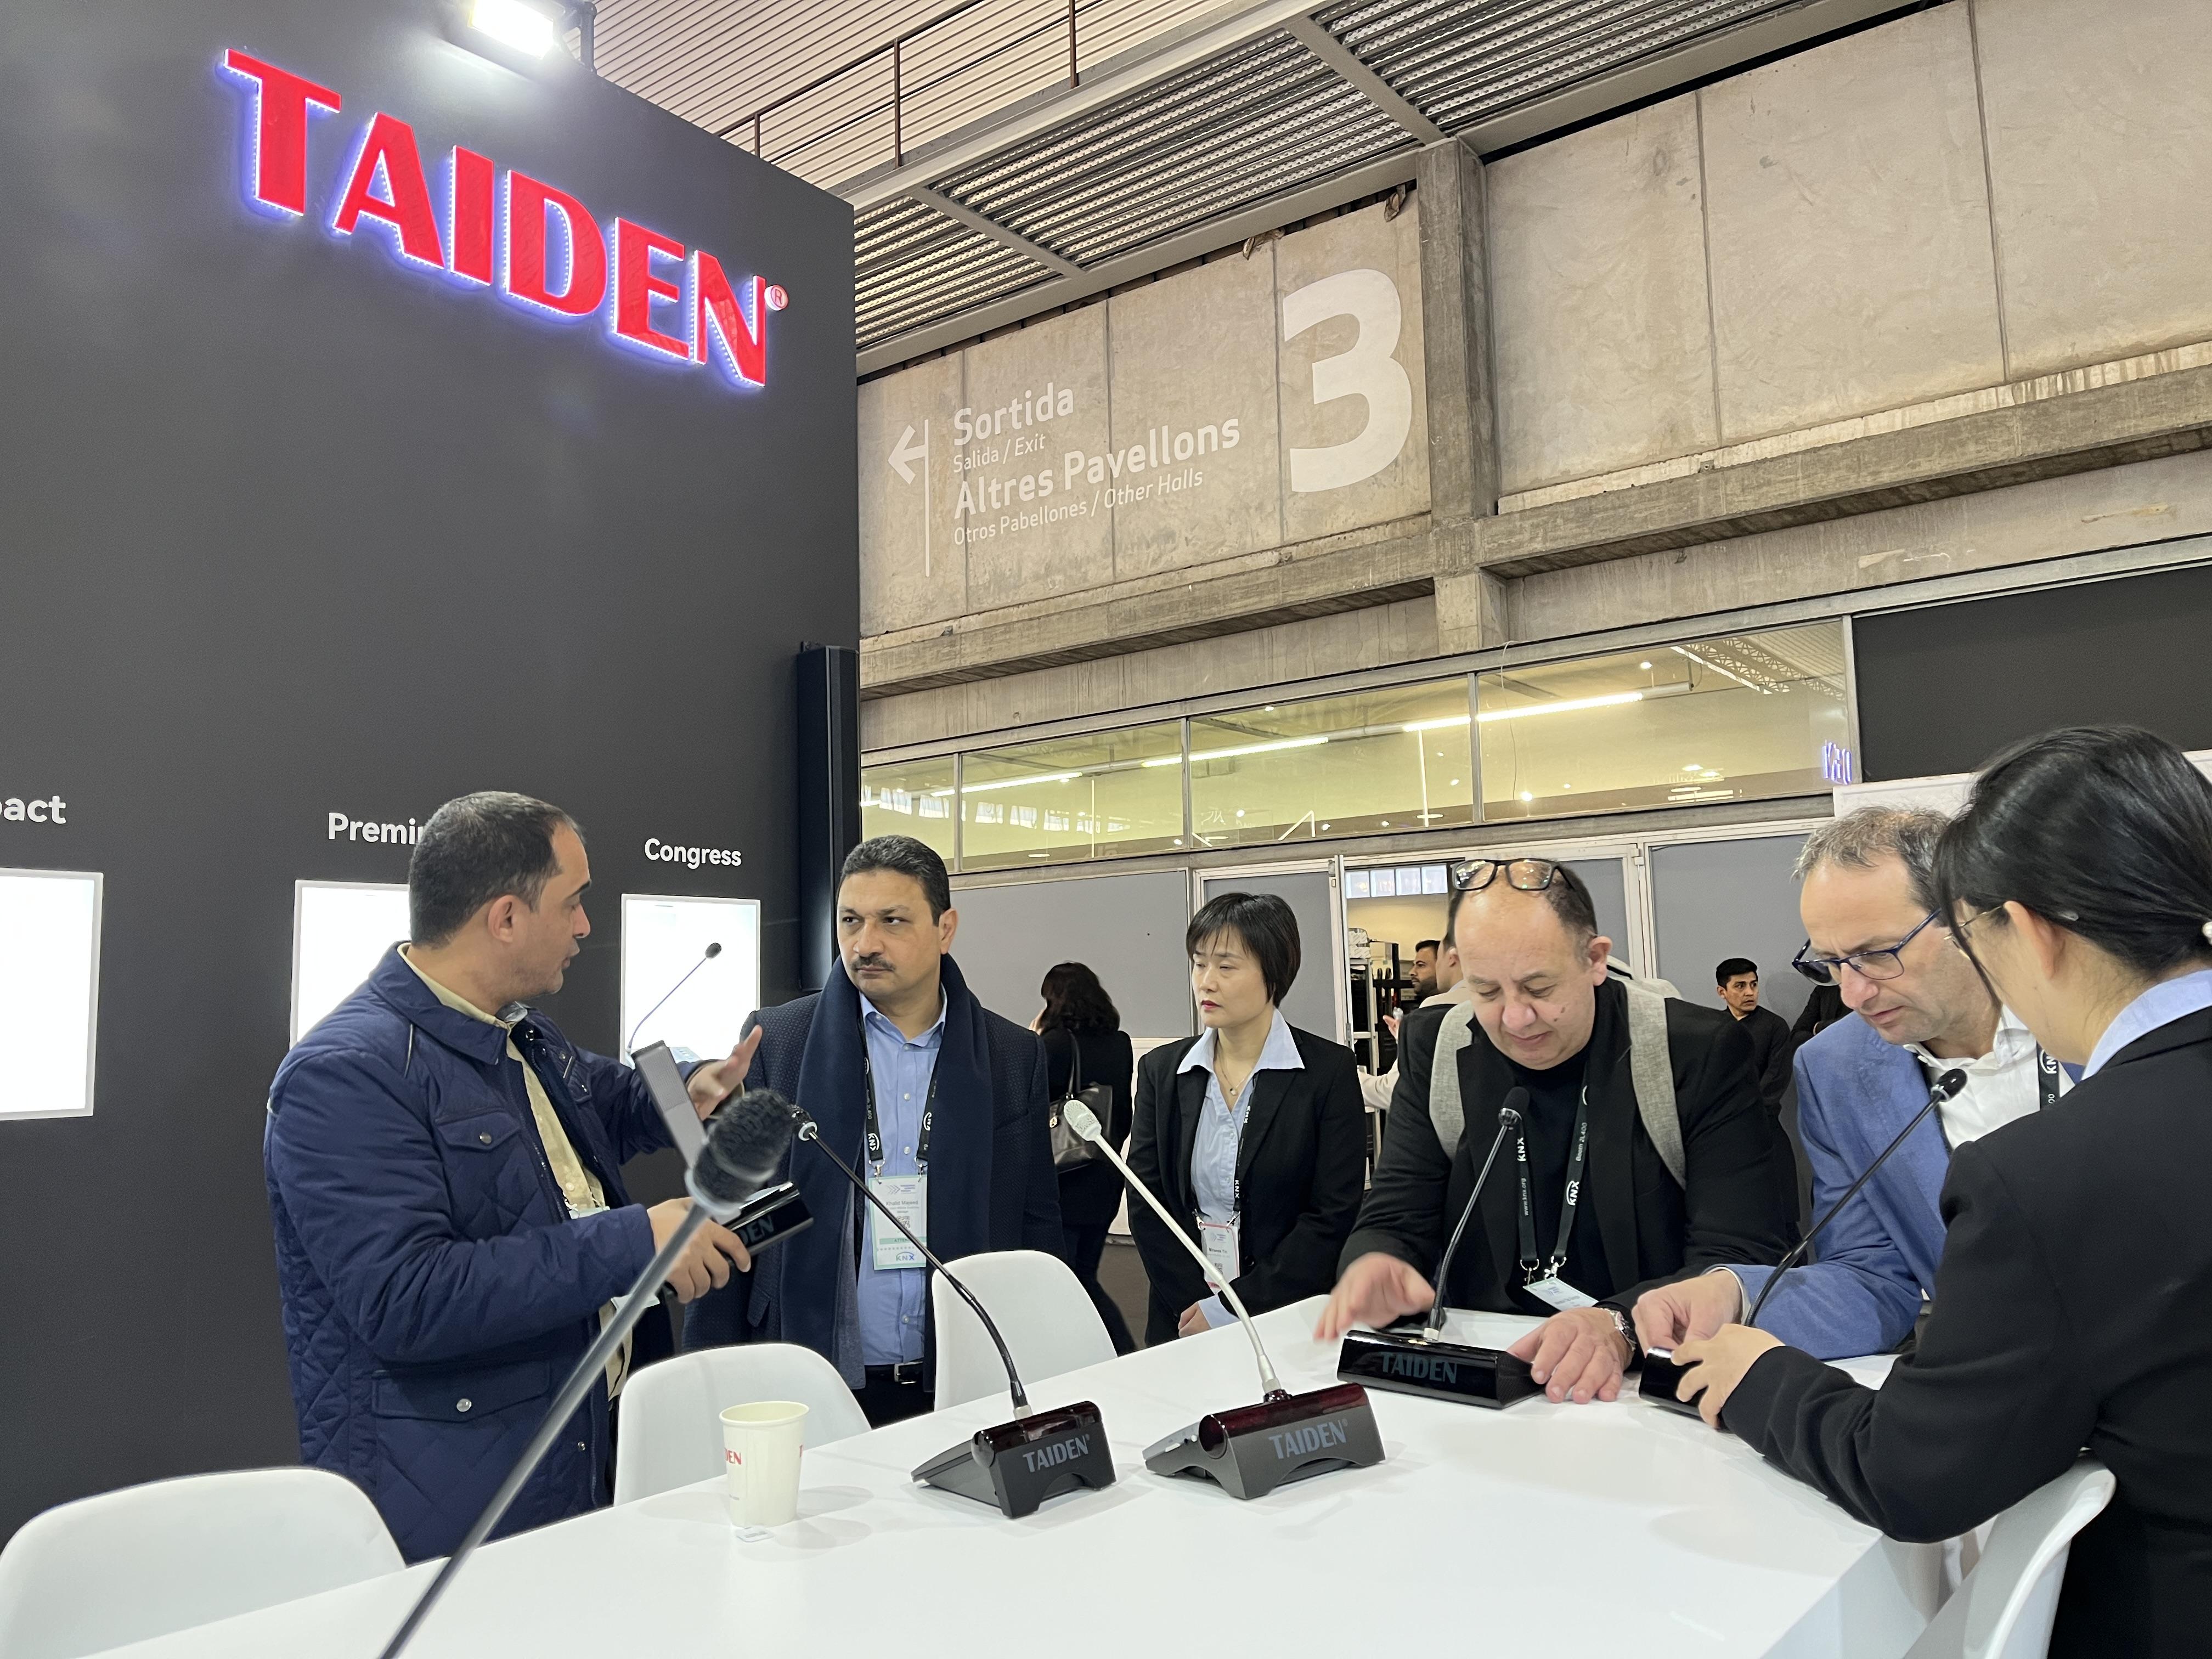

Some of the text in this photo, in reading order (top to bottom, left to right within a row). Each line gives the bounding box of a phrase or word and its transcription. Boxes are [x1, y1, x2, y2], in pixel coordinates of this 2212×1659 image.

[1283, 269, 1412, 492] 3
[953, 382, 1074, 446] Sortida
[953, 449, 999, 473] Salida
[1014, 433, 1046, 456] Exit
[954, 419, 1240, 519] Altres Pavellons
[954, 521, 996, 545] Otros
[1000, 499, 1087, 534] Pabellones
[1104, 481, 1153, 508] Other
[1158, 468, 1203, 495] Halls
[0, 795, 66, 824] act
[644, 838, 742, 870] Congress
[1517, 1137, 1526, 1162] KNX
[1568, 1181, 1580, 1206] KNX
[1380, 1351, 1458, 1384] TAIDEN
